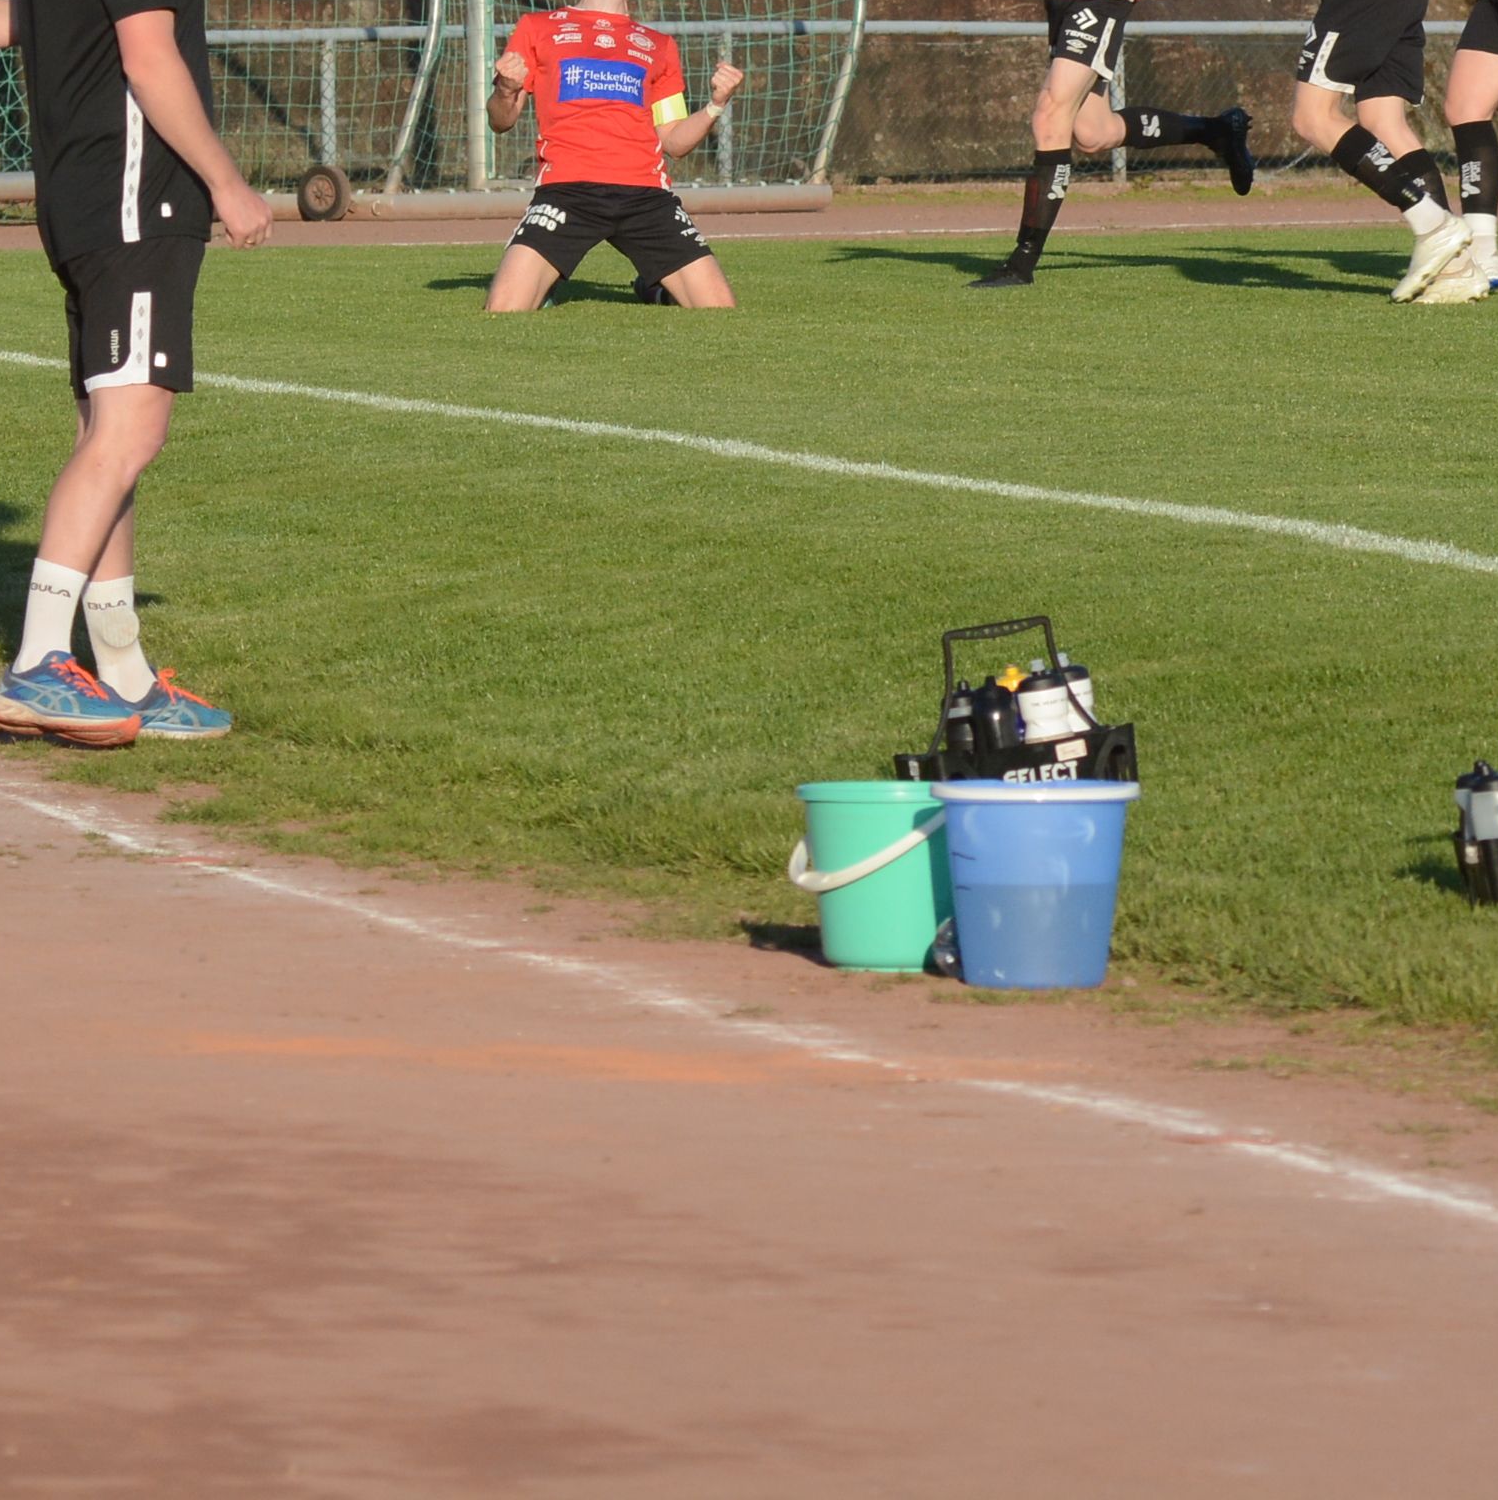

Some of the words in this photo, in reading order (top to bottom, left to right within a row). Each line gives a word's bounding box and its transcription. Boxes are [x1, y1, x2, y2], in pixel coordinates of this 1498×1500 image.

[583, 80, 639, 97] Sparebank
[584, 69, 642, 87] Flekkefjord
[110, 328, 120, 364] umbro
[1003, 760, 1079, 784] SELECT
